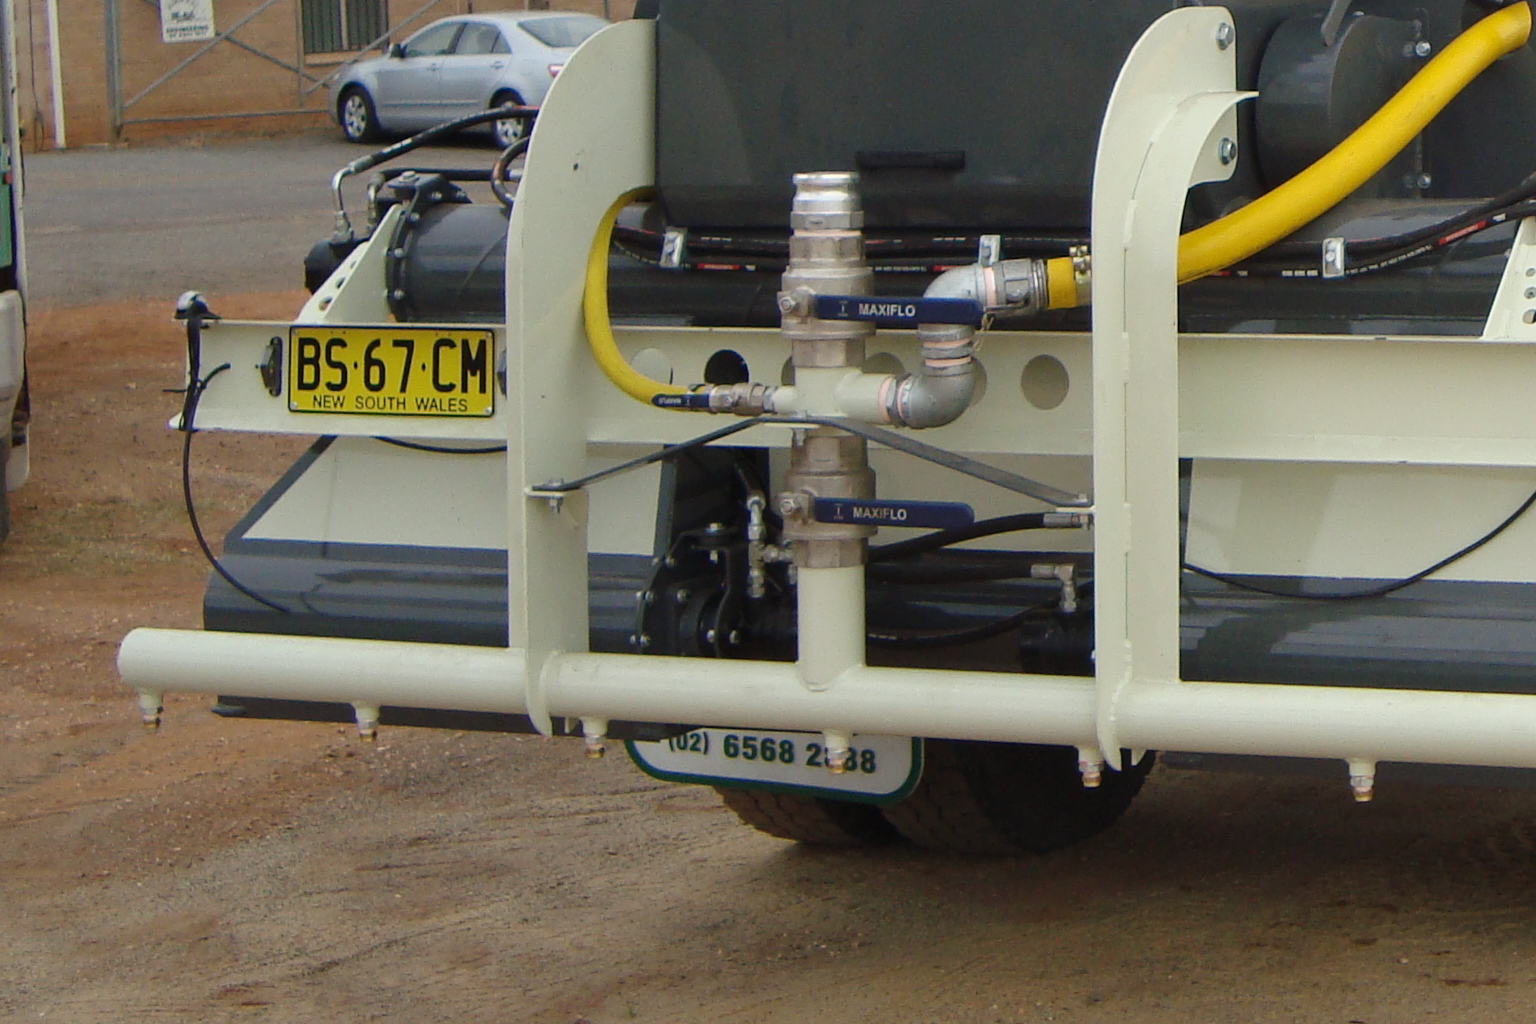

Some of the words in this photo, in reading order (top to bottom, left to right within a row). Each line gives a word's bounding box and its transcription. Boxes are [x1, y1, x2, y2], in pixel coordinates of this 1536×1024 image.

[858, 302, 916, 317] MAXIFLO
[313, 394, 346, 408] NEW
[355, 395, 406, 410] SOUTH
[415, 397, 468, 412] WALES
[853, 506, 907, 521] MAXIFLO
[668, 731, 709, 755] (02)
[723, 734, 795, 764] 6568
[806, 743, 877, 774] 288
